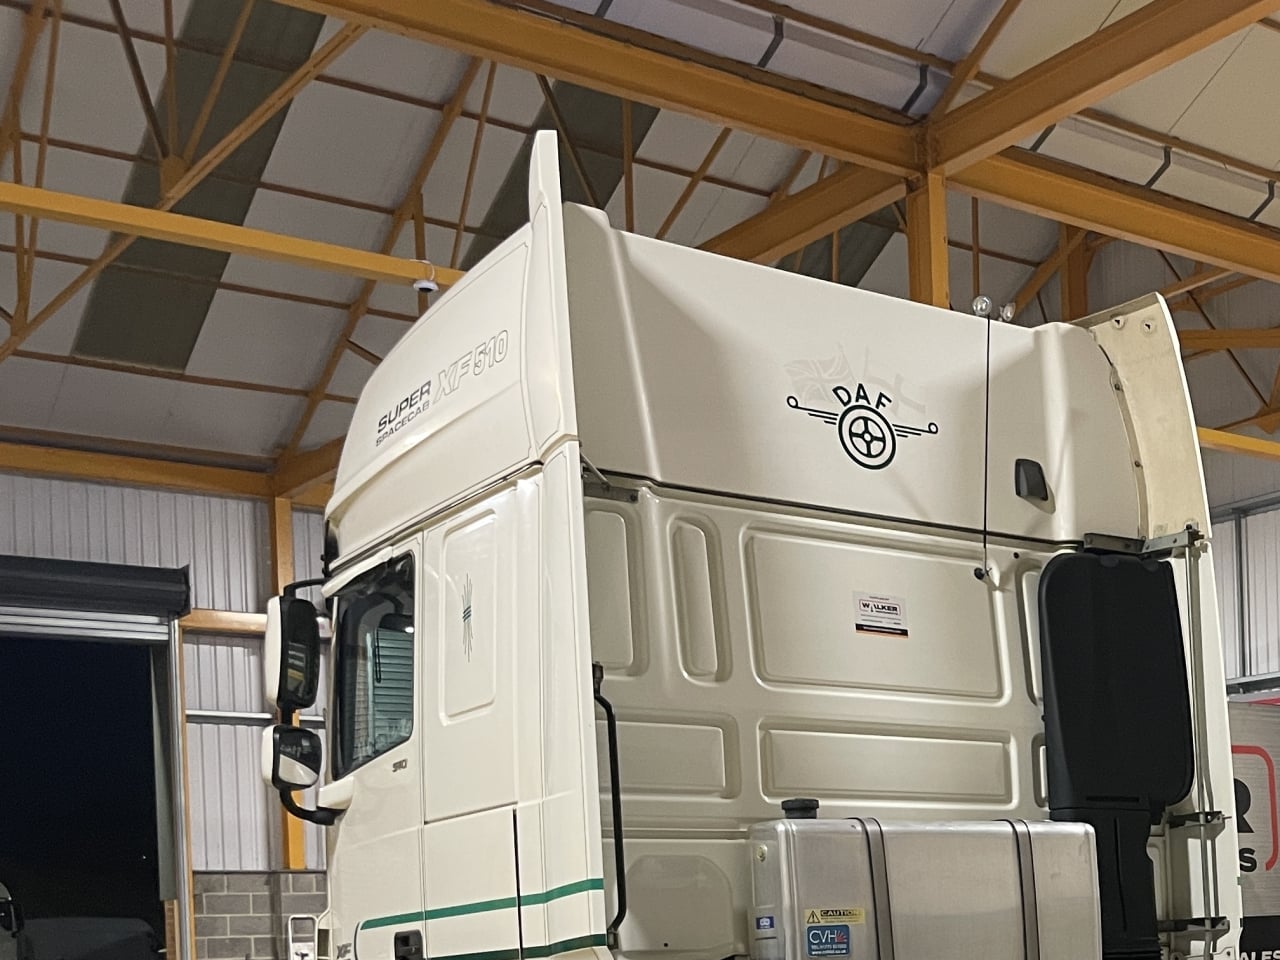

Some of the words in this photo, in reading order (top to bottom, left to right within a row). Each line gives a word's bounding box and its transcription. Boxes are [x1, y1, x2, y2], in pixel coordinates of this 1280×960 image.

[378, 380, 431, 434] SUPER
[432, 350, 473, 405] XF
[473, 329, 508, 376] 510
[832, 383, 892, 410] DAF
[376, 400, 430, 447] SPACECAB
